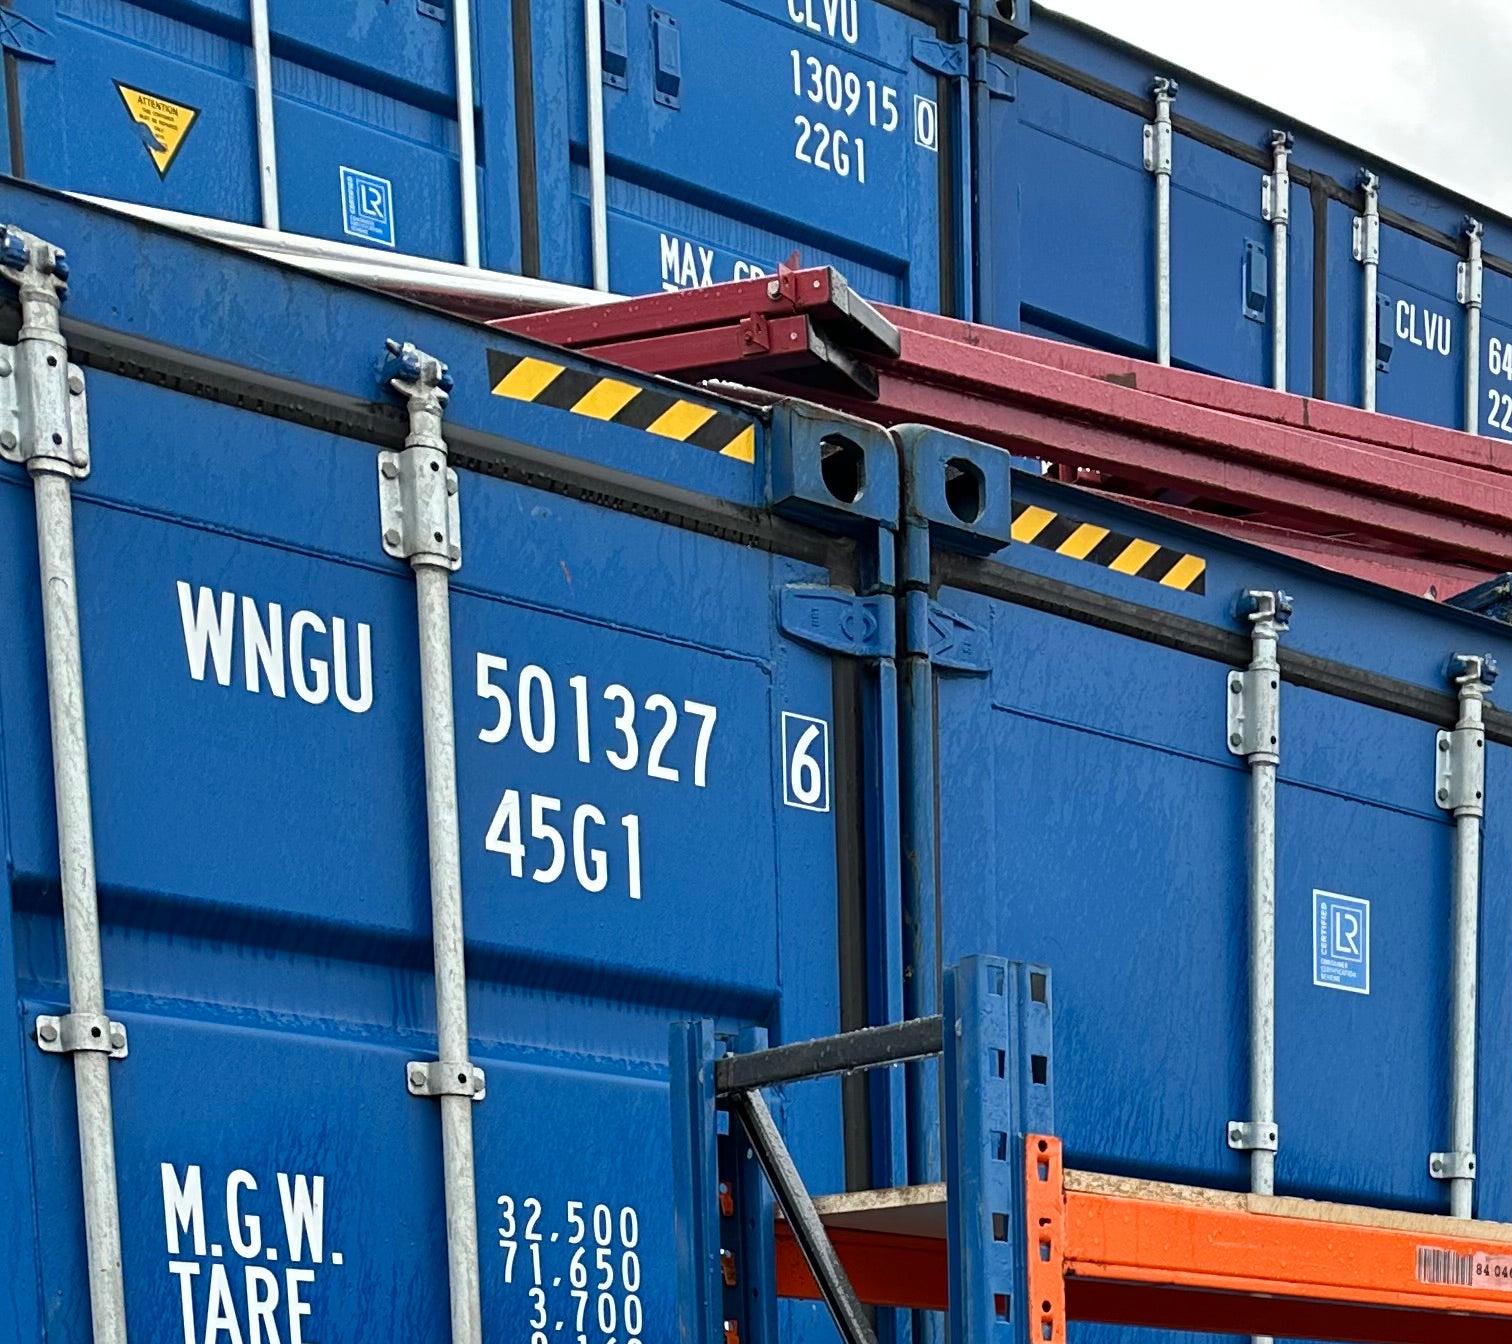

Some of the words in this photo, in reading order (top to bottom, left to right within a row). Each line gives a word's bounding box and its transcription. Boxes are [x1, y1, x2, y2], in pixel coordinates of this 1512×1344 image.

[788, 0, 858, 43] CLVU
[137, 96, 179, 117] ATTENTION
[791, 50, 898, 132] 130915
[915, 98, 936, 148] 0
[794, 115, 865, 184] 22G1
[361, 184, 384, 218] LR
[1396, 300, 1451, 356] CLVU
[177, 581, 372, 713] WNGU
[476, 652, 716, 786] 501327
[786, 717, 825, 808] 6
[486, 790, 641, 899] 45G1
[1336, 911, 1359, 955] LR
[161, 1162, 343, 1265] M.G.W.
[1476, 1264, 1490, 1276] 84
